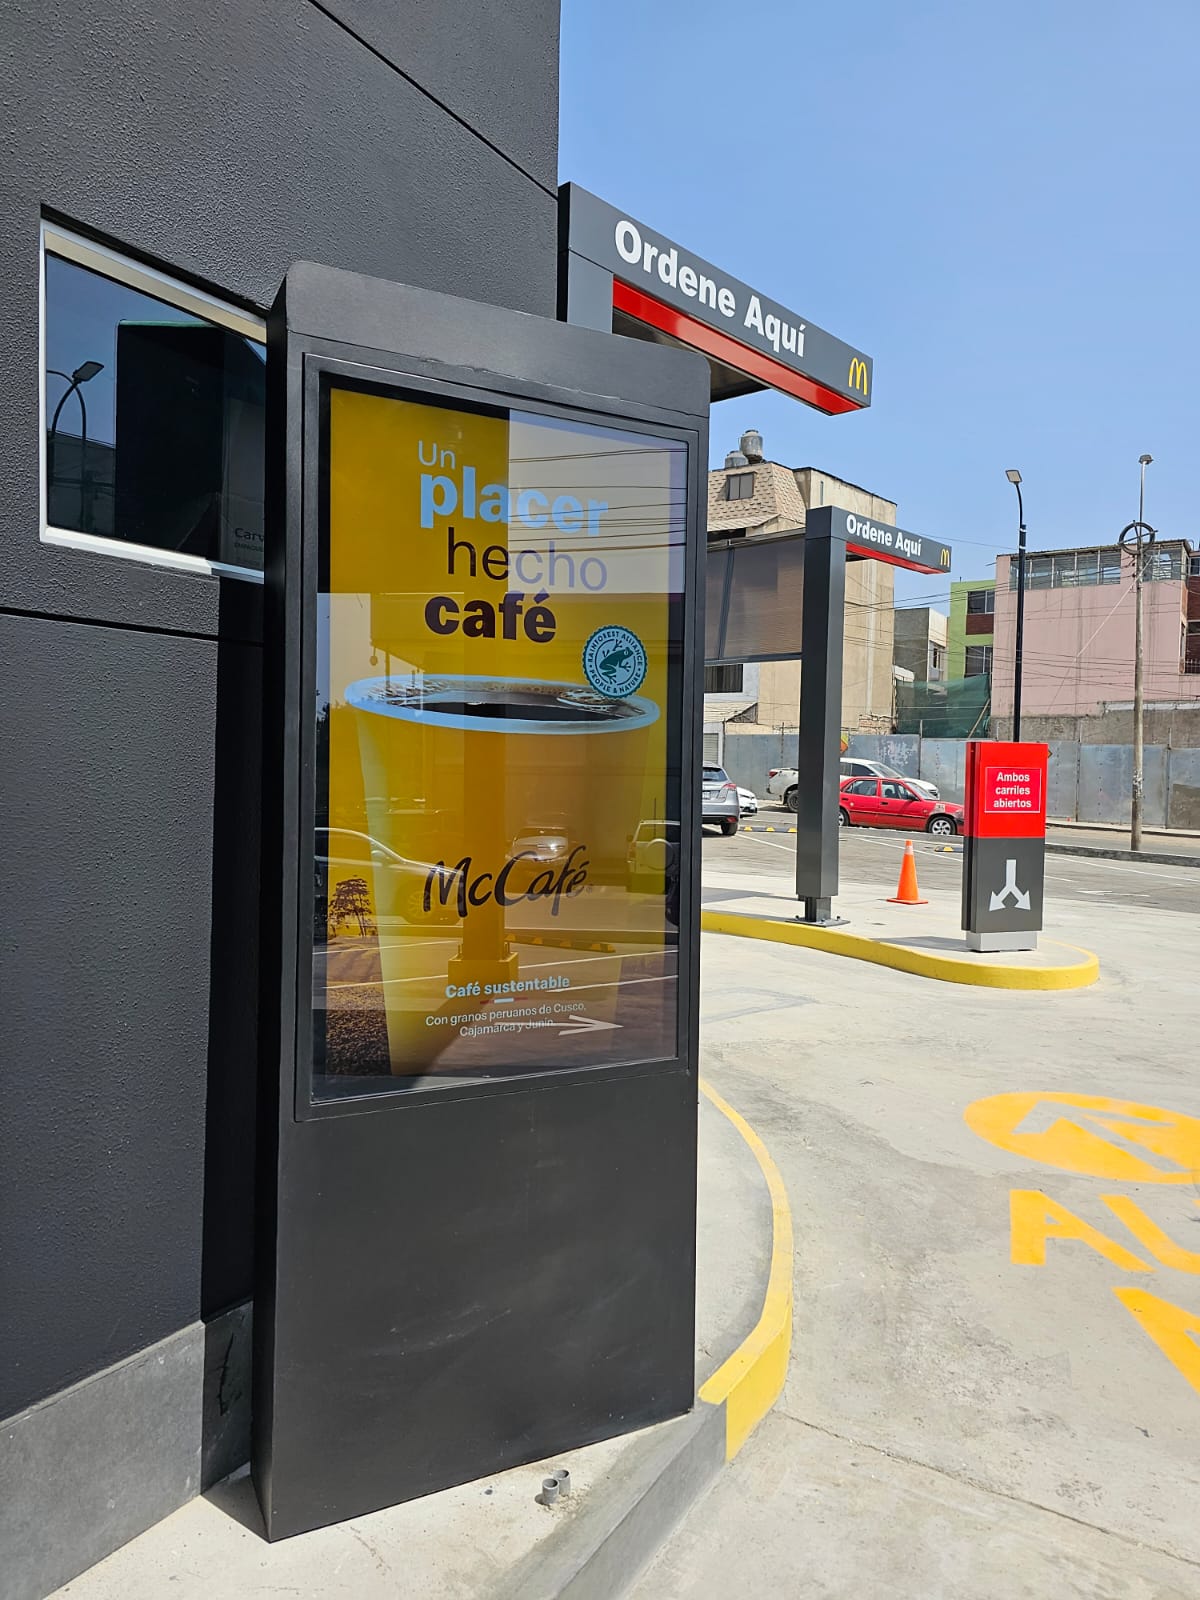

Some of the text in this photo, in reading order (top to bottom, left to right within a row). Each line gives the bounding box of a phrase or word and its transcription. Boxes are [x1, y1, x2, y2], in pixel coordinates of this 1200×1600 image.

[614, 220, 806, 357] Ordene Aquí
[418, 440, 456, 470] Un
[420, 466, 609, 536] placer
[846, 514, 922, 557] Ordene Aquí
[447, 527, 608, 592] hecho
[424, 589, 556, 643] café
[588, 631, 643, 666] RAINFOREST ALLIANCE
[589, 670, 611, 692] PEOPLE
[620, 672, 641, 693] NATURE
[995, 785, 1031, 795] carriles
[996, 771, 1031, 782] Ambos
[993, 798, 1032, 808] abiertos
[423, 845, 590, 917] McCafé
[445, 976, 570, 999] Café sustentable
[425, 1016, 448, 1026] Con
[450, 1011, 488, 1026] granos
[489, 1007, 537, 1022] peruanos
[539, 1004, 552, 1014] de
[459, 1021, 515, 1038] Cajamarca
[516, 1023, 523, 1033] y
